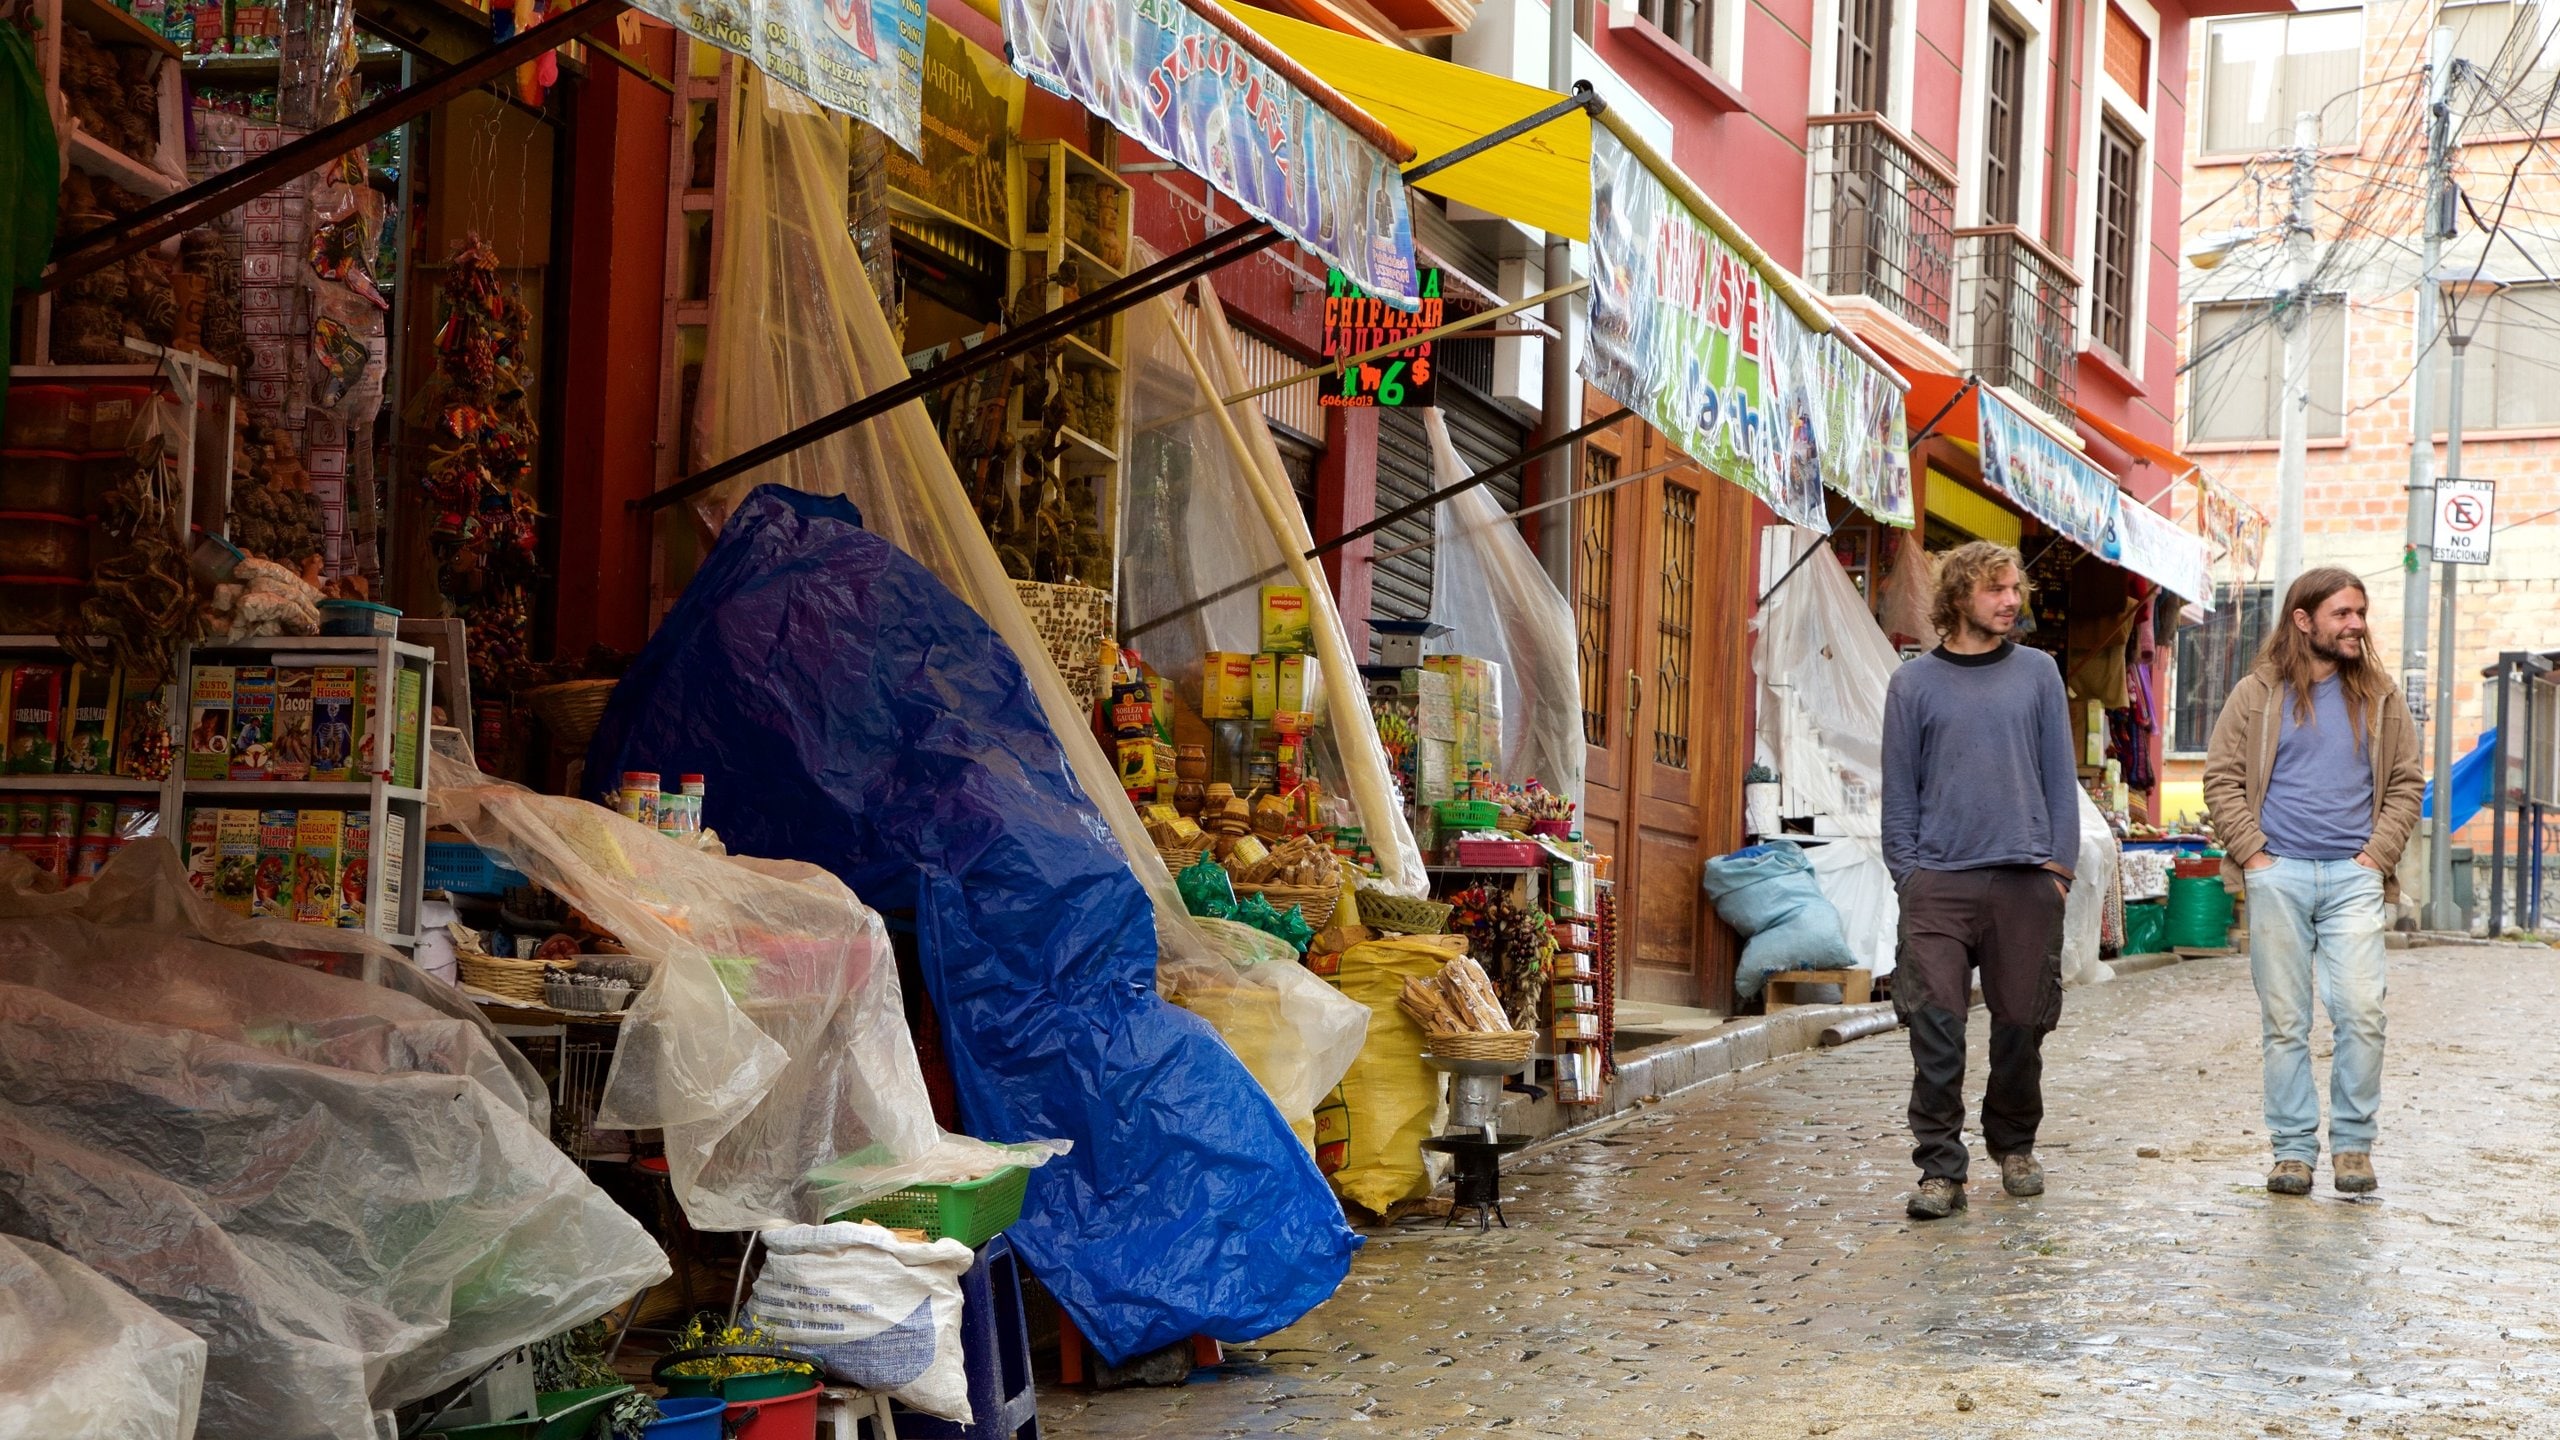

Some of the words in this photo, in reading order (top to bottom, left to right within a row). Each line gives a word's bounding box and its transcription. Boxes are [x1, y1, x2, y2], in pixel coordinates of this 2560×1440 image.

[690, 12, 752, 51] BAÑOS
[812, 50, 869, 89] MPIEZA
[766, 51, 872, 117] FLOREMIENTO
[1328, 268, 1441, 299] TIA
[1323, 326, 1433, 358] LOURDES
[2455, 502, 2473, 524] E
[2450, 535, 2472, 548] NO
[2433, 547, 2490, 562] ESTACIONAR
[199, 680, 228, 690] SUSTO
[316, 687, 352, 698] Huesos
[192, 689, 232, 699] NERVIOS
[15, 708, 52, 723] ERBAMATE
[74, 706, 109, 721] ERBAMATE
[1115, 706, 1144, 714] NOBLEZA
[1116, 714, 1142, 722] GAUCHA
